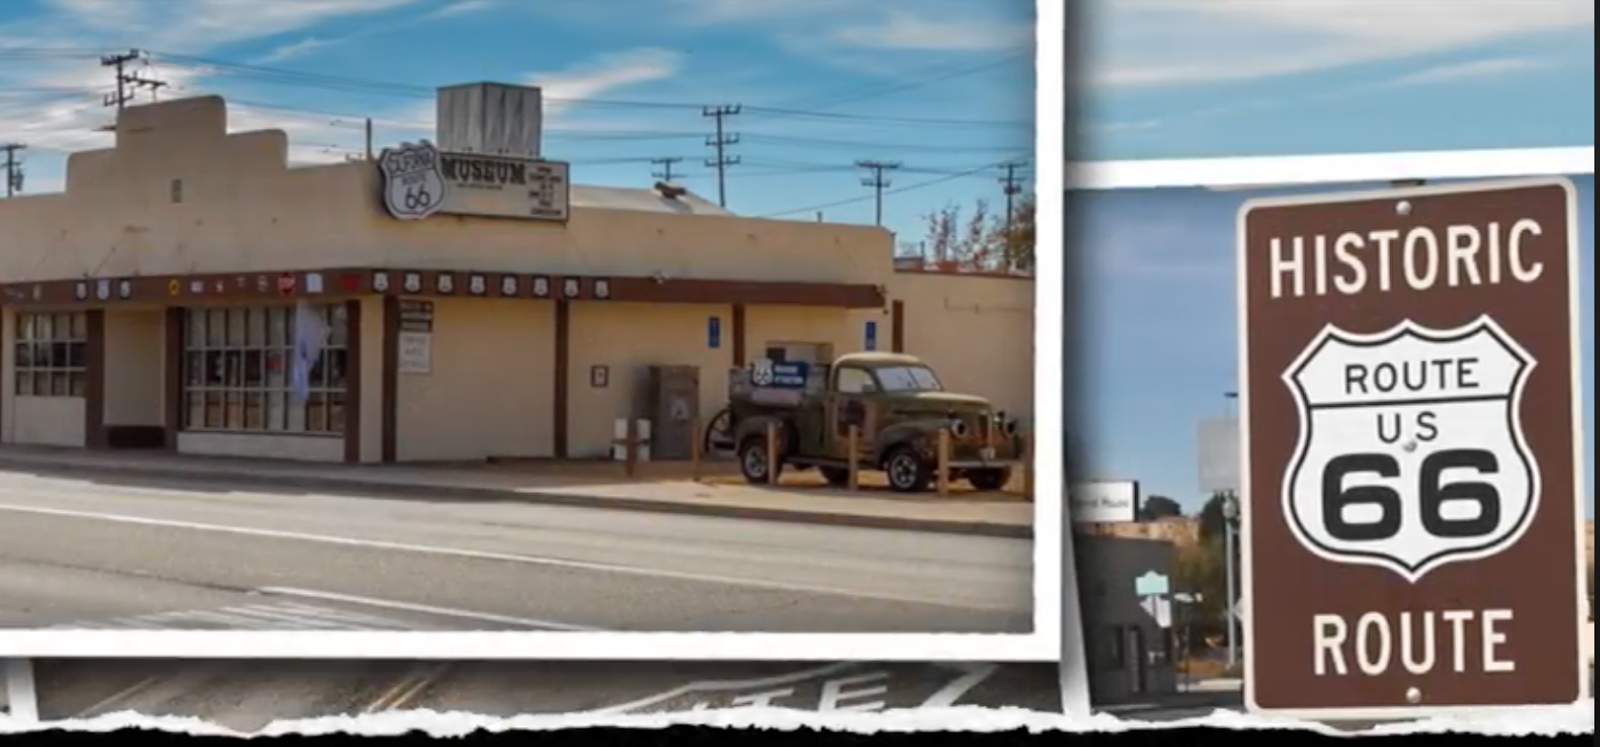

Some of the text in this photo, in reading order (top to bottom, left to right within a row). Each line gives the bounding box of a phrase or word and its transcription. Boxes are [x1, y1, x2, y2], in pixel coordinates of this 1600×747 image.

[440, 156, 527, 185] MUSEUM
[405, 184, 431, 210] 66
[1270, 218, 1544, 298] HISTORIC
[1345, 357, 1480, 395] ROUTE
[1322, 448, 1500, 541] 66
[1313, 609, 1515, 676] ROUTE
